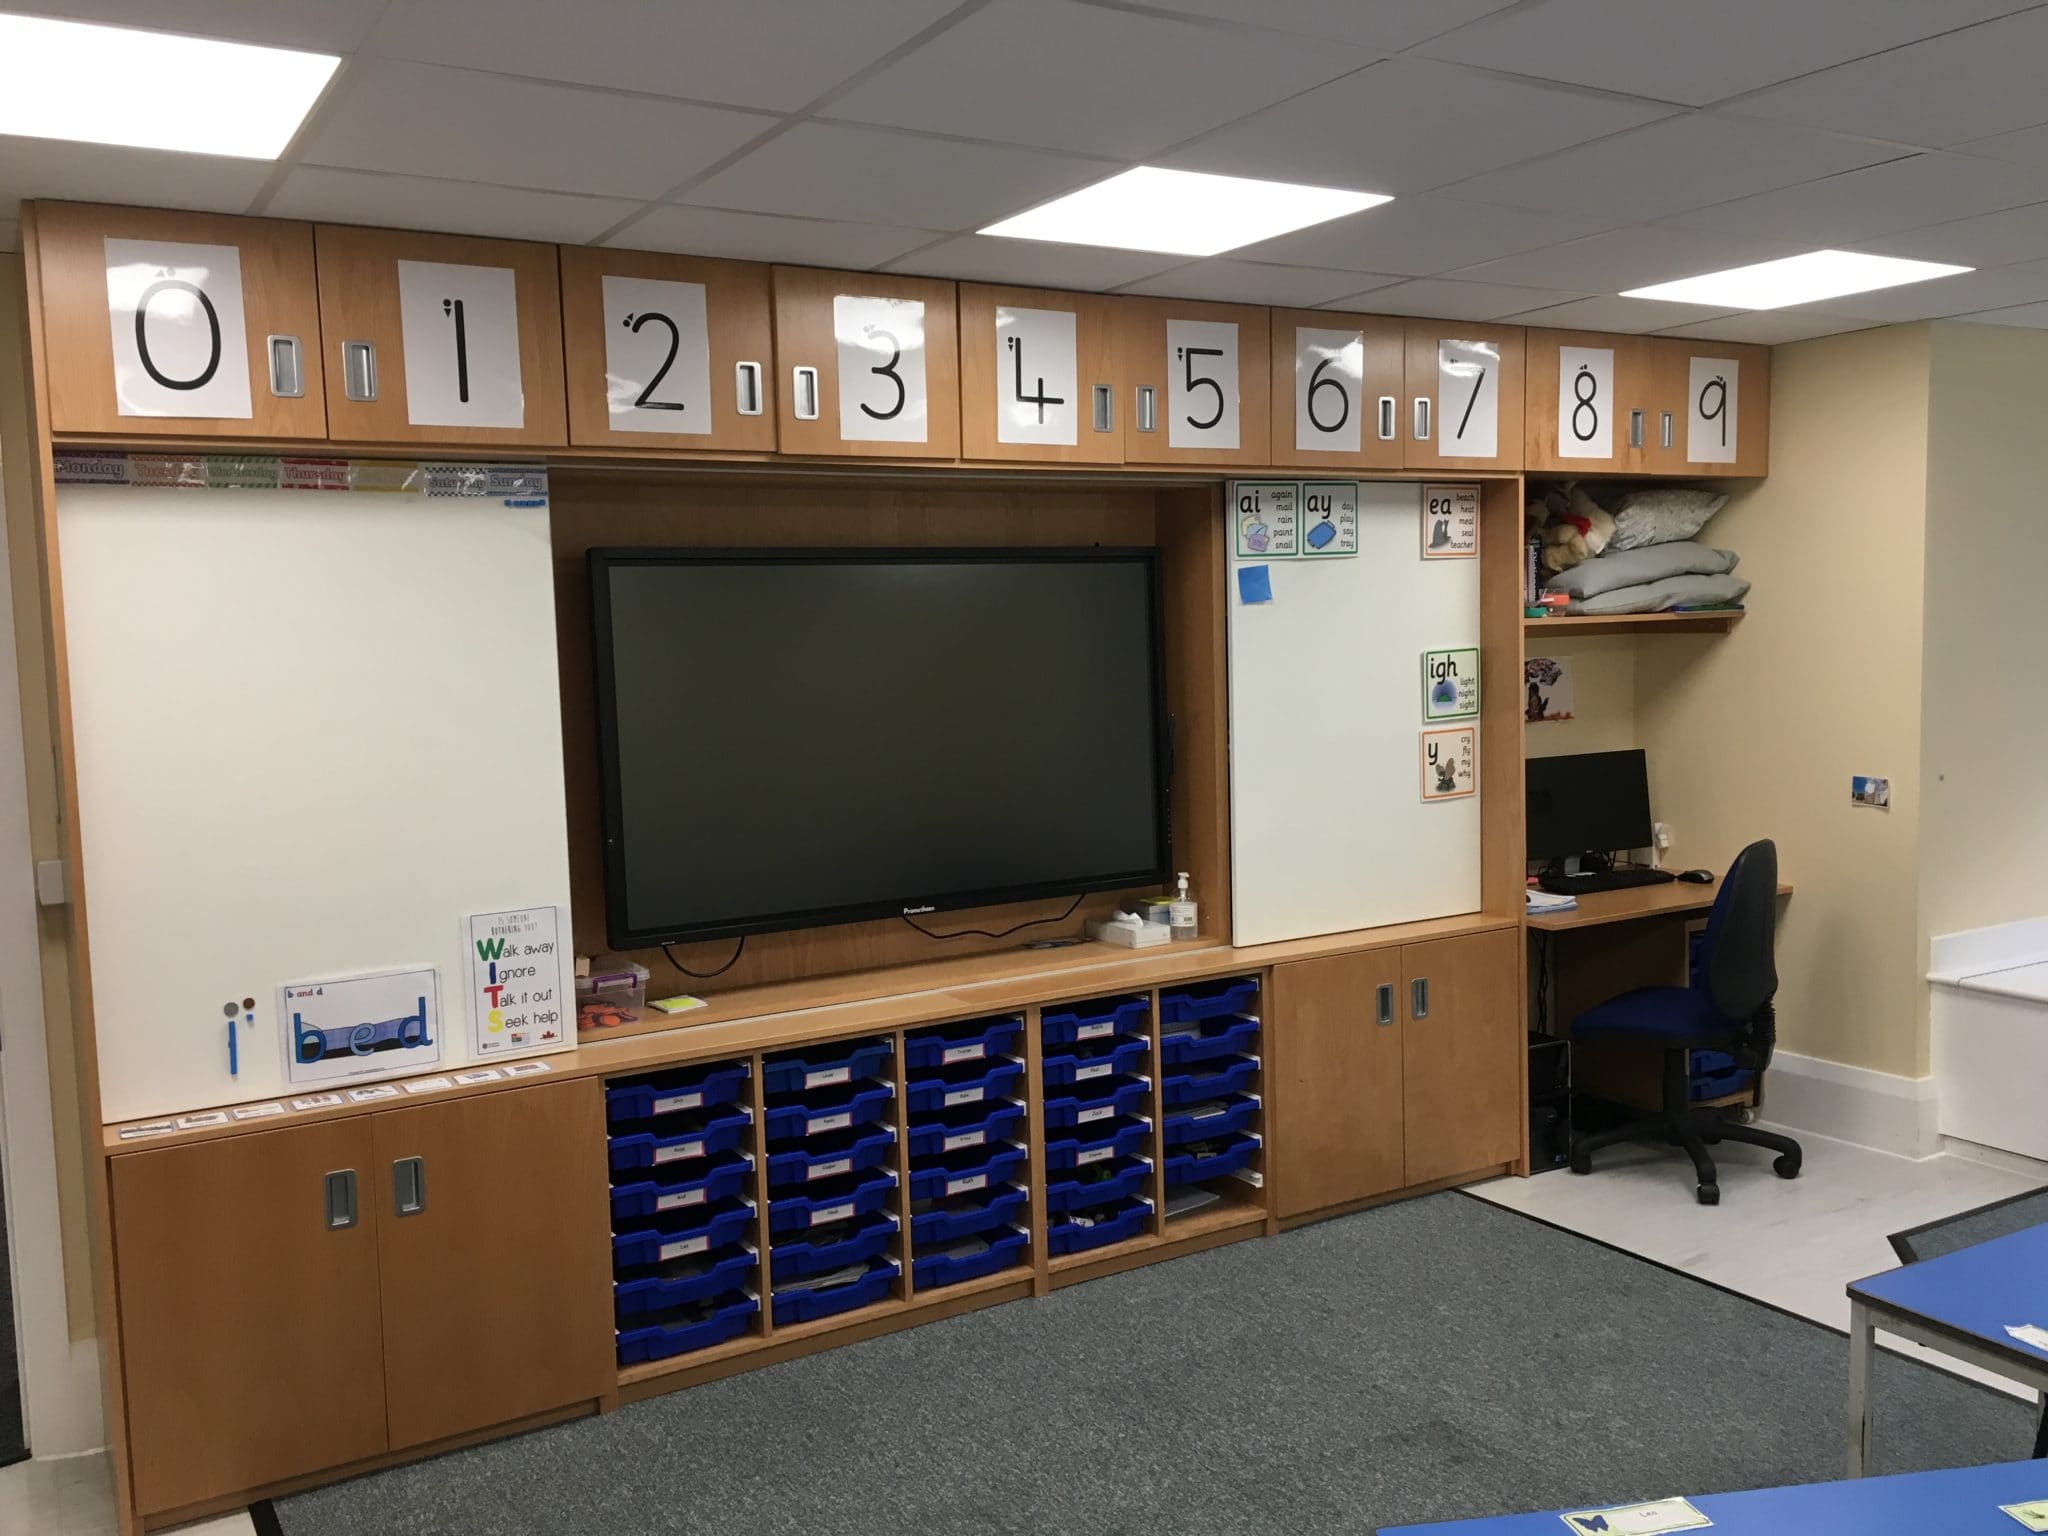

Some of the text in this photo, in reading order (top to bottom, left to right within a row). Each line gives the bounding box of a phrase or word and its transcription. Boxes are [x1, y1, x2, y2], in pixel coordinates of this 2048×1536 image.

[136, 279, 222, 391] 0
[453, 299, 469, 404] 1
[631, 311, 686, 411] 2
[860, 329, 906, 420] 3
[1014, 336, 1065, 425] 4
[1185, 347, 1224, 430] 5
[1307, 356, 1350, 433] 6
[1452, 364, 1486, 440] 7
[1571, 370, 1599, 442] 8
[1698, 379, 1727, 447] 9
[55, 459, 125, 479] Monday
[283, 465, 346, 482] Thursday
[1240, 490, 1261, 513] ai
[1271, 490, 1293, 501] again
[1456, 492, 1475, 502] beach
[1276, 503, 1293, 512] mail
[1307, 494, 1332, 520] ay
[1341, 501, 1354, 512] day
[1429, 498, 1452, 515] ea
[1460, 505, 1475, 514] heat
[1277, 515, 1293, 524] rain
[1340, 514, 1354, 525] play
[1459, 517, 1474, 525] meal
[1273, 528, 1294, 539] paint
[1342, 527, 1354, 537] say
[1461, 529, 1474, 537] seal
[1275, 540, 1293, 550] snail
[1340, 539, 1354, 550] tray
[1450, 540, 1474, 550] teacher
[1430, 654, 1458, 685] igh
[1460, 676, 1475, 687] light
[1458, 688, 1475, 699] night
[1459, 700, 1475, 711] sight
[1460, 735, 1471, 745] cry
[1427, 742, 1439, 766] y
[1462, 745, 1471, 756] fly
[1460, 758, 1471, 768] my
[1458, 768, 1471, 779] why
[476, 937, 555, 962] Walk away
[488, 962, 536, 985] Ignore
[287, 987, 323, 999] b and d
[483, 984, 553, 1009] Talk it out
[487, 1009, 559, 1033] Seek help
[293, 996, 434, 1064] bed
